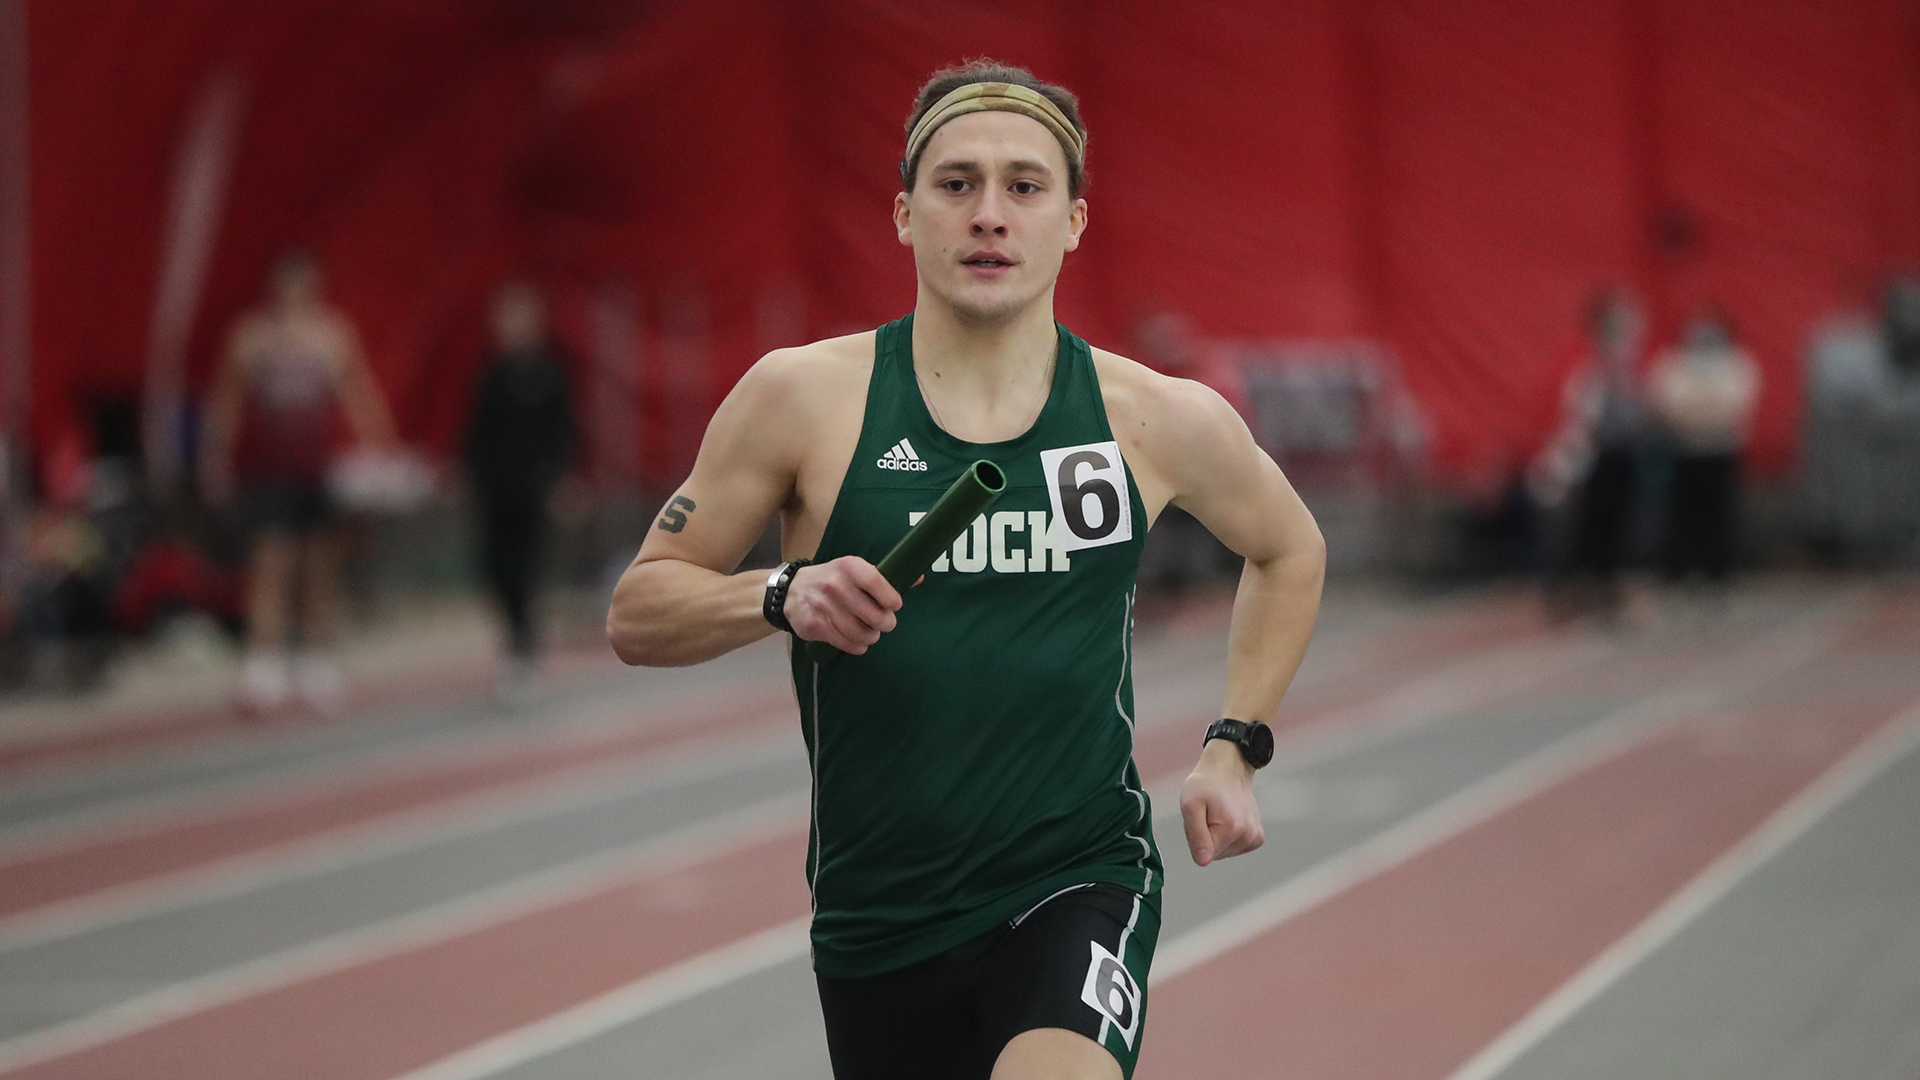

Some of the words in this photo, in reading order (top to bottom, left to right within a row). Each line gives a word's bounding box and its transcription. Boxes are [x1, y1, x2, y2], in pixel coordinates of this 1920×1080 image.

[877, 457, 928, 471] adidas
[1057, 450, 1120, 540] 6
[658, 495, 696, 534] S
[909, 511, 1070, 573] OCK
[1096, 957, 1134, 1030] 6
